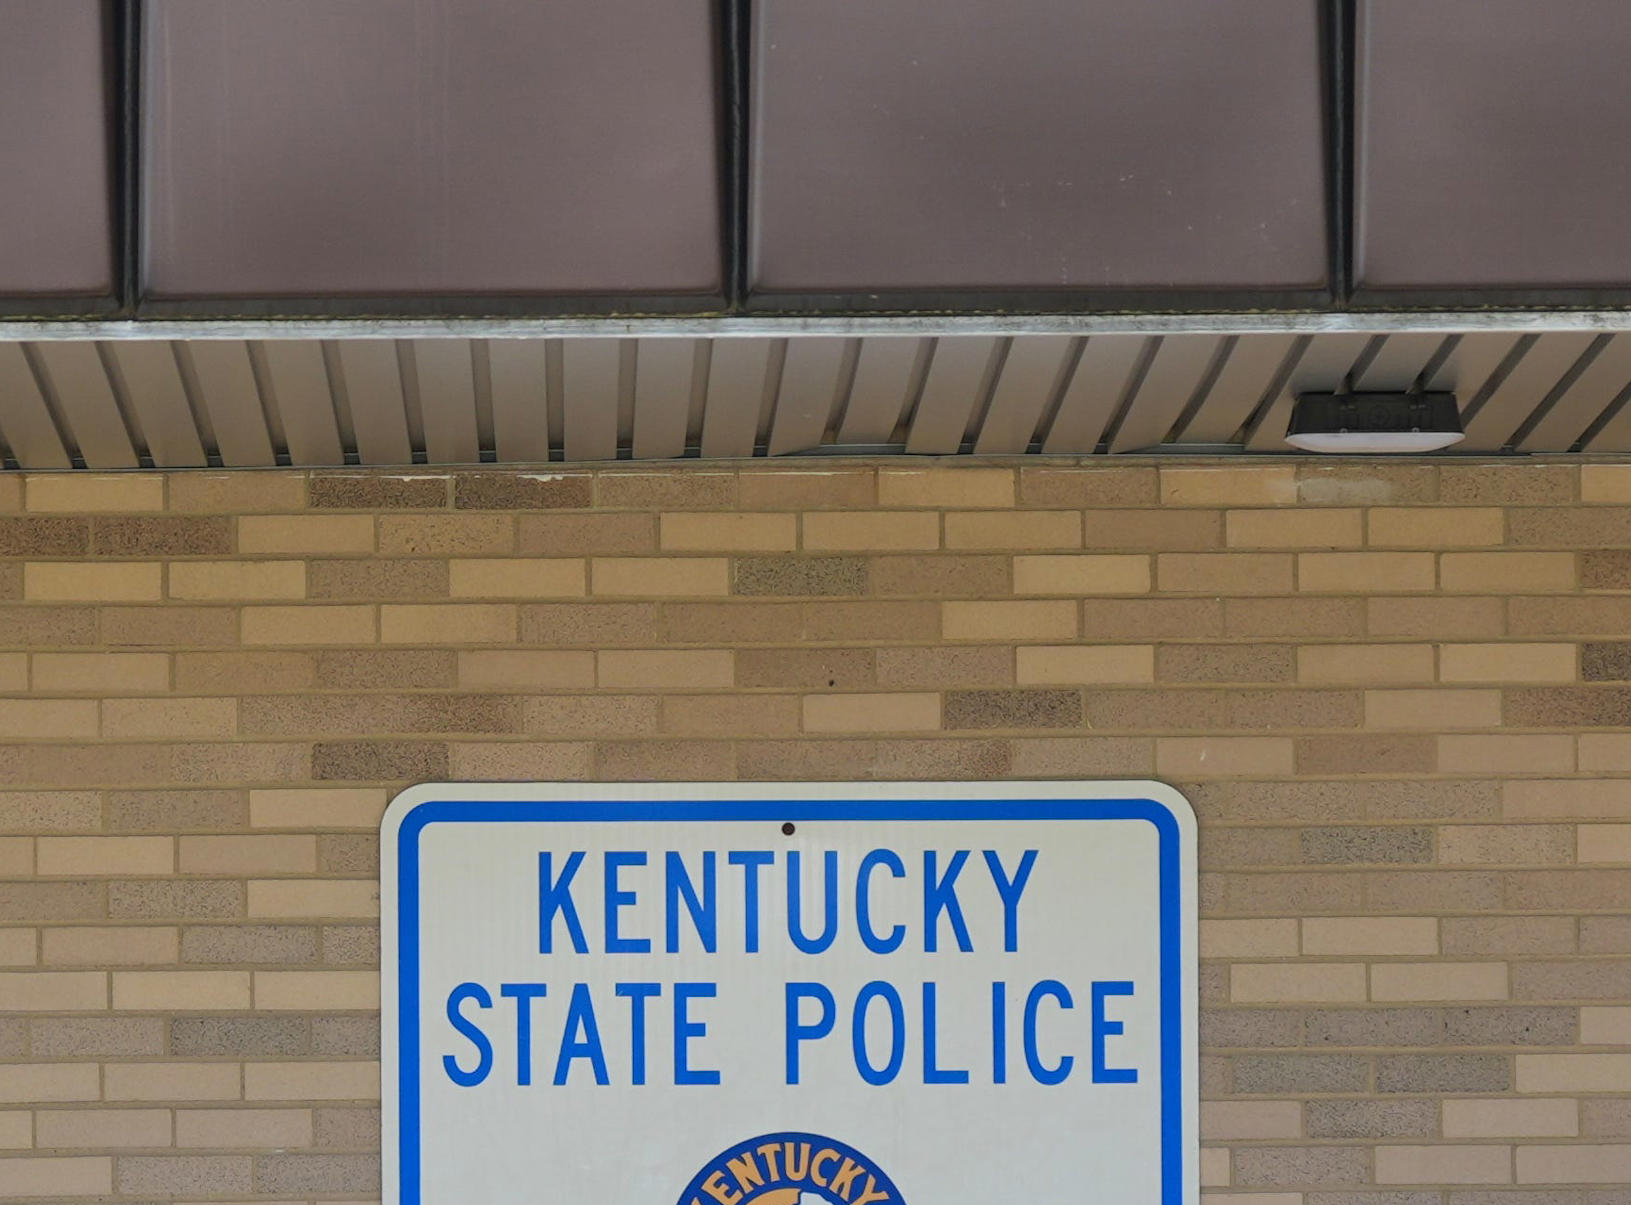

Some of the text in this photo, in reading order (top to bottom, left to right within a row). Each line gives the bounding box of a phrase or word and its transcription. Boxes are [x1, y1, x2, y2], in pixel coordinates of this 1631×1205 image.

[538, 848, 1040, 955] KENTUCKY
[442, 979, 1139, 1088] STATE POLICE
